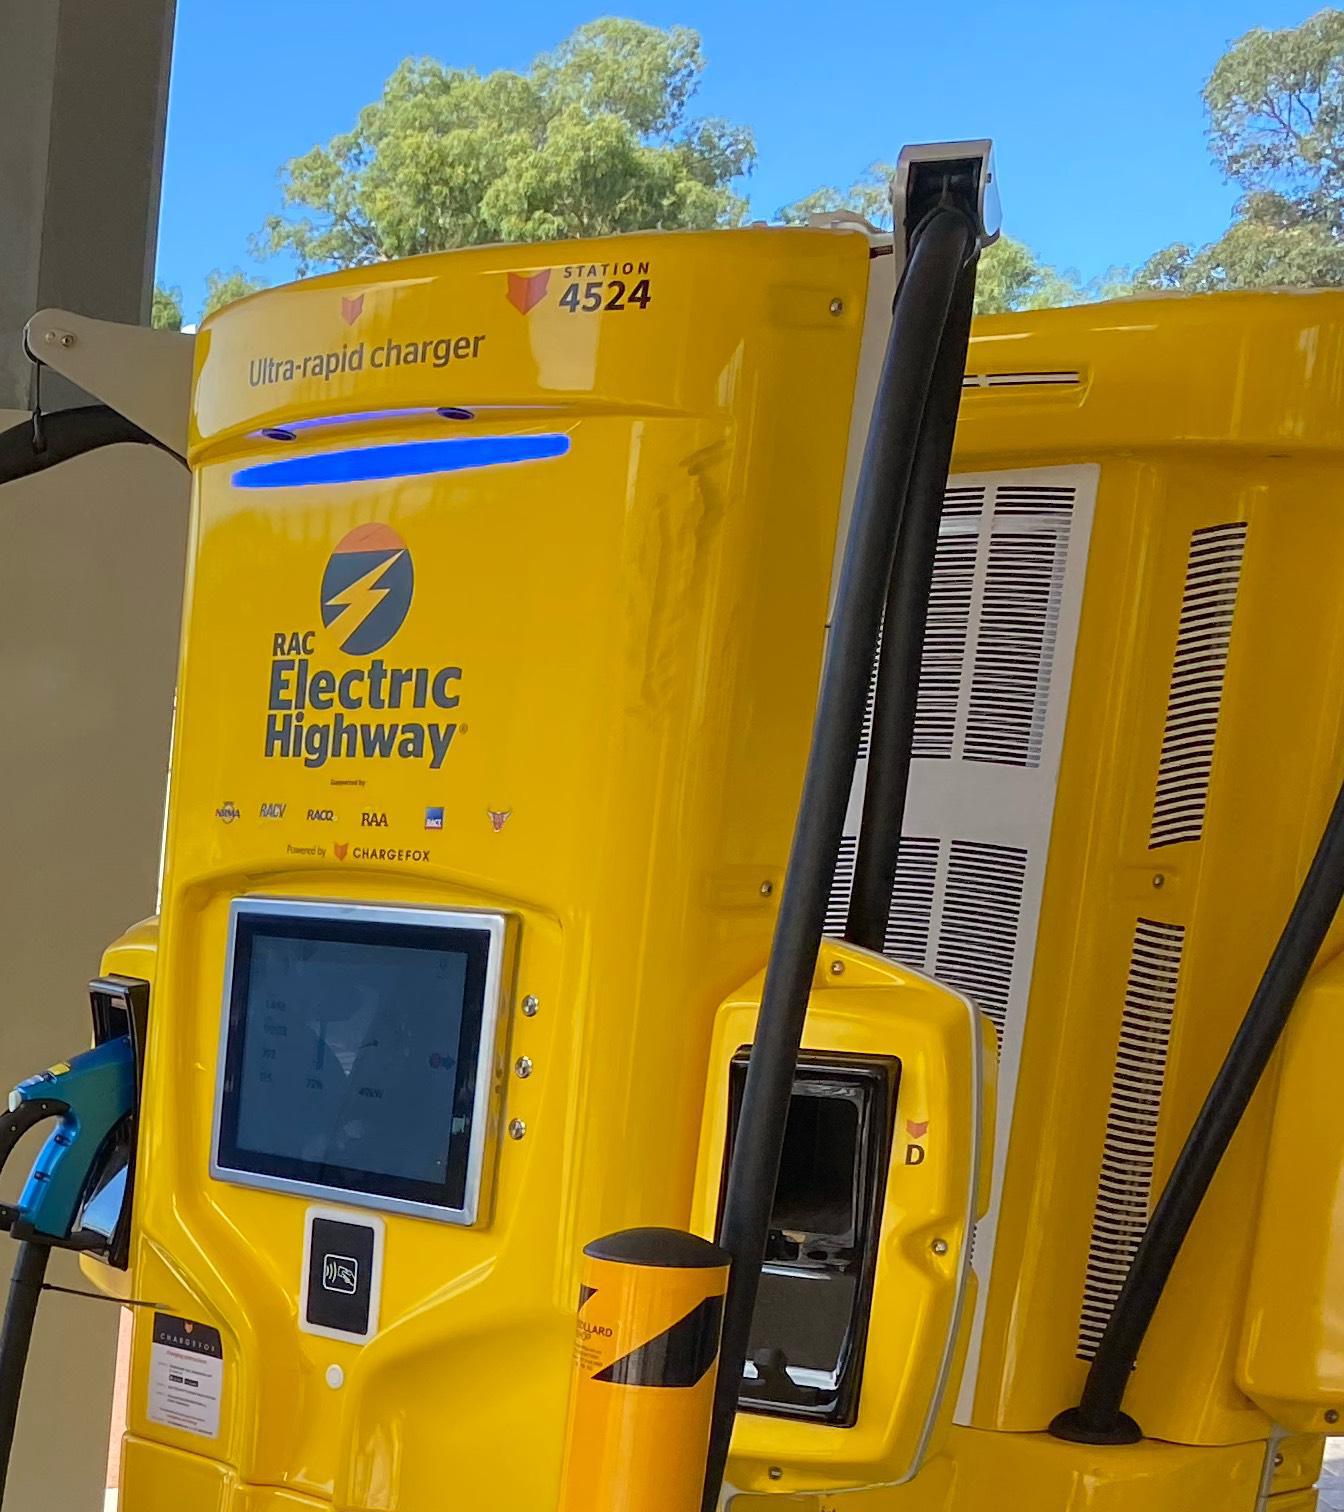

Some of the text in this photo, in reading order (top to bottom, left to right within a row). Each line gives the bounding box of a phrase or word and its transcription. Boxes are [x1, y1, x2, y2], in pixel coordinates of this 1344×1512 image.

[563, 262, 650, 279] STATION
[558, 279, 652, 313] 4524
[248, 334, 486, 388] Ultra-rapid charger
[272, 630, 316, 657] RAC
[267, 658, 463, 711] Electric
[259, 802, 287, 819] RACV
[306, 808, 334, 822] RACQ
[361, 812, 389, 827] RAA
[286, 844, 326, 858] Powered by
[352, 847, 431, 862] CHARGEFOX
[905, 1143, 925, 1166] D
